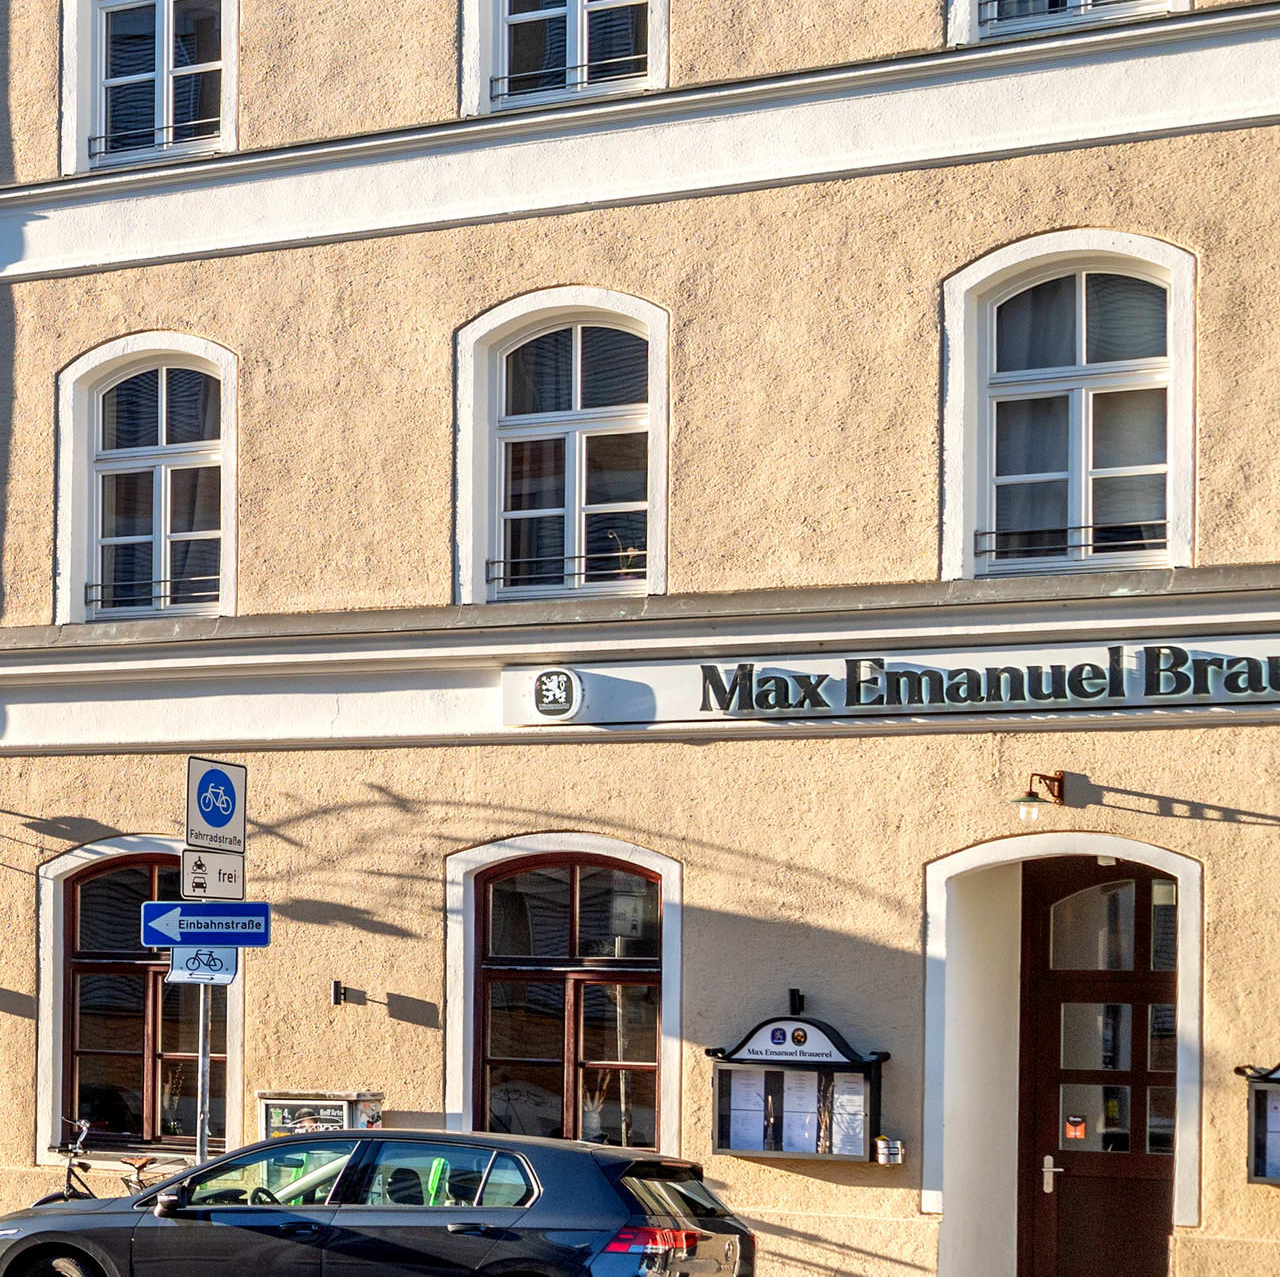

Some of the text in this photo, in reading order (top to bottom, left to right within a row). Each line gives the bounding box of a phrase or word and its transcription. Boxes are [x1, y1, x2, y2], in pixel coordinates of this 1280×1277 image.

[699, 663, 831, 711] Max
[844, 645, 1126, 707] Emanuel
[190, 828, 242, 847] Fahrradstraße
[217, 868, 237, 884] frei
[178, 919, 261, 930] Einbahnstraße
[765, 1049, 798, 1057] Emanuel
[799, 1050, 832, 1058] Brauerei
